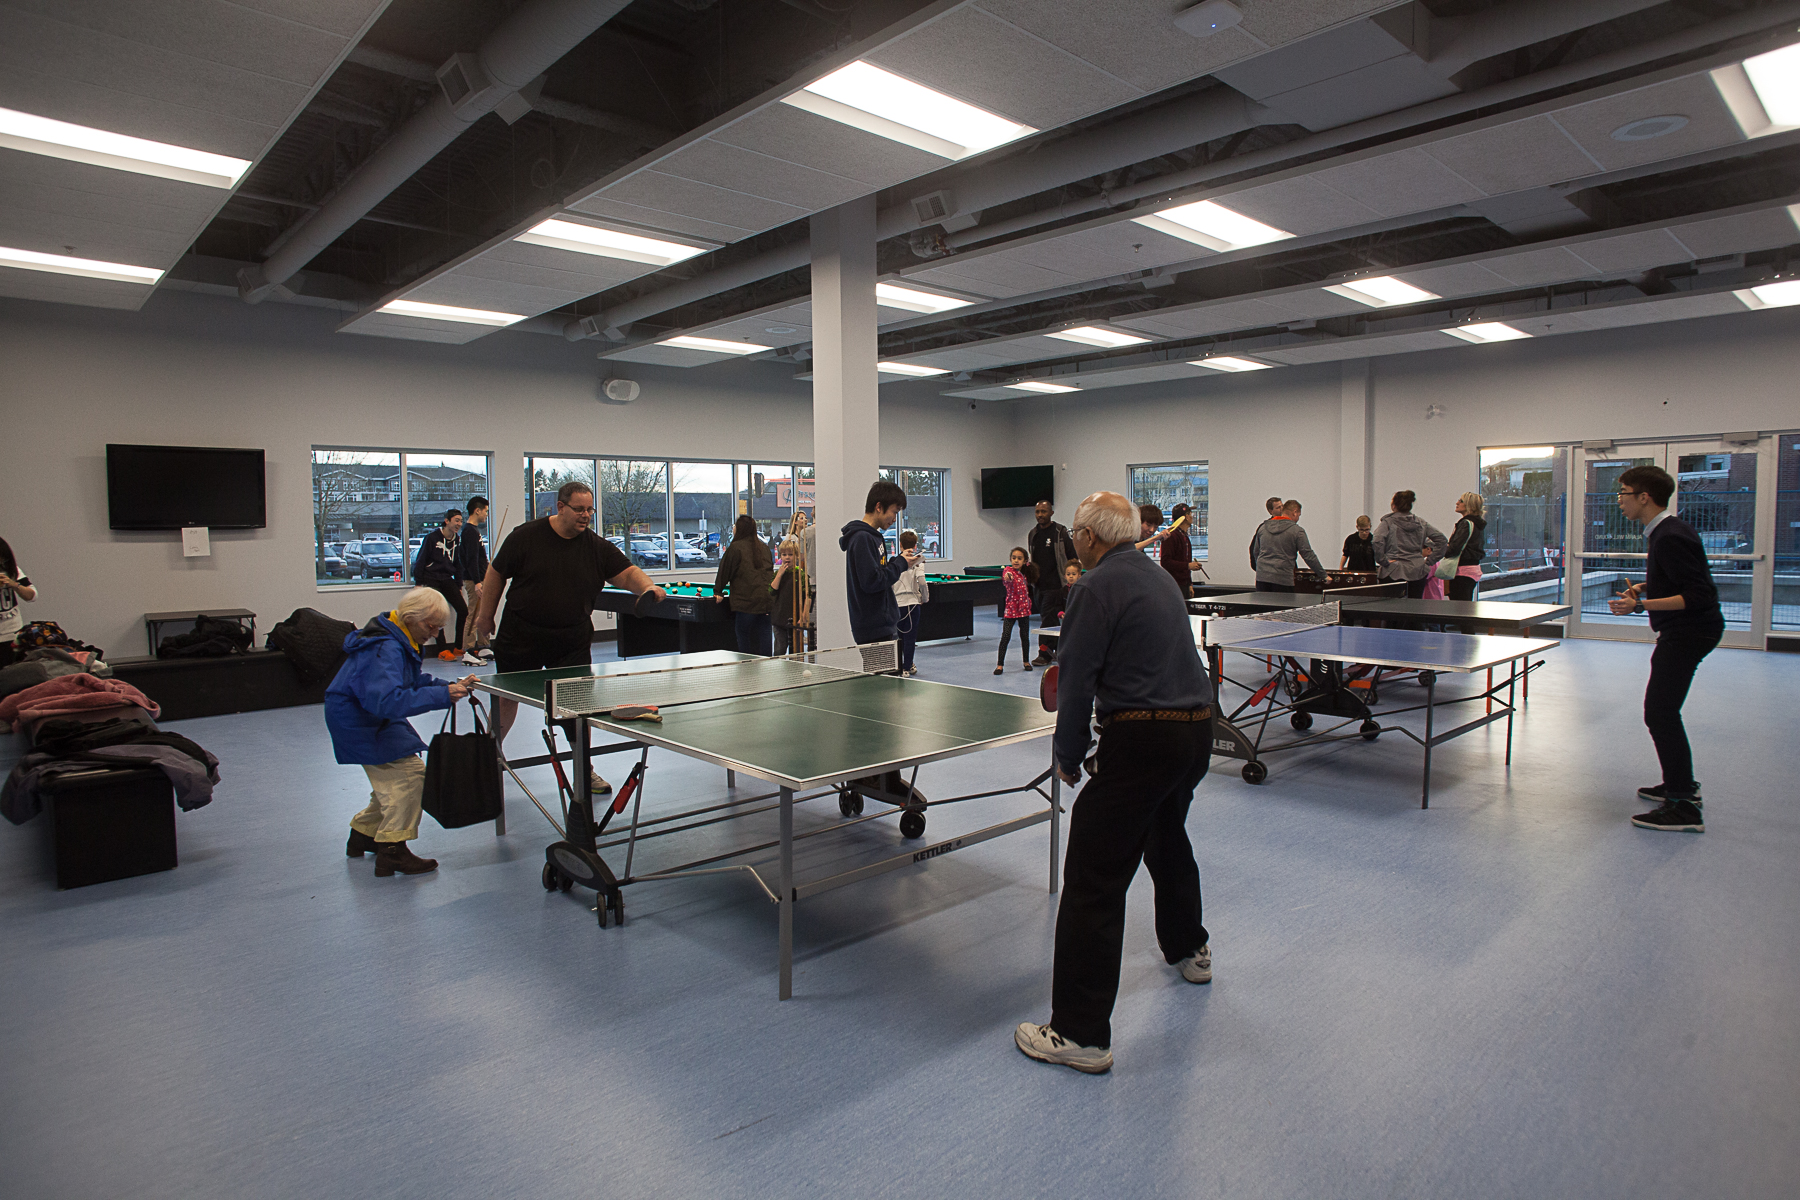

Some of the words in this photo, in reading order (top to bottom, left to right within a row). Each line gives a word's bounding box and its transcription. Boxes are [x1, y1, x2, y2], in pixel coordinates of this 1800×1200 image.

[1212, 738, 1236, 752] LER
[913, 842, 953, 863] KETTLER
[1050, 1034, 1066, 1048] N
